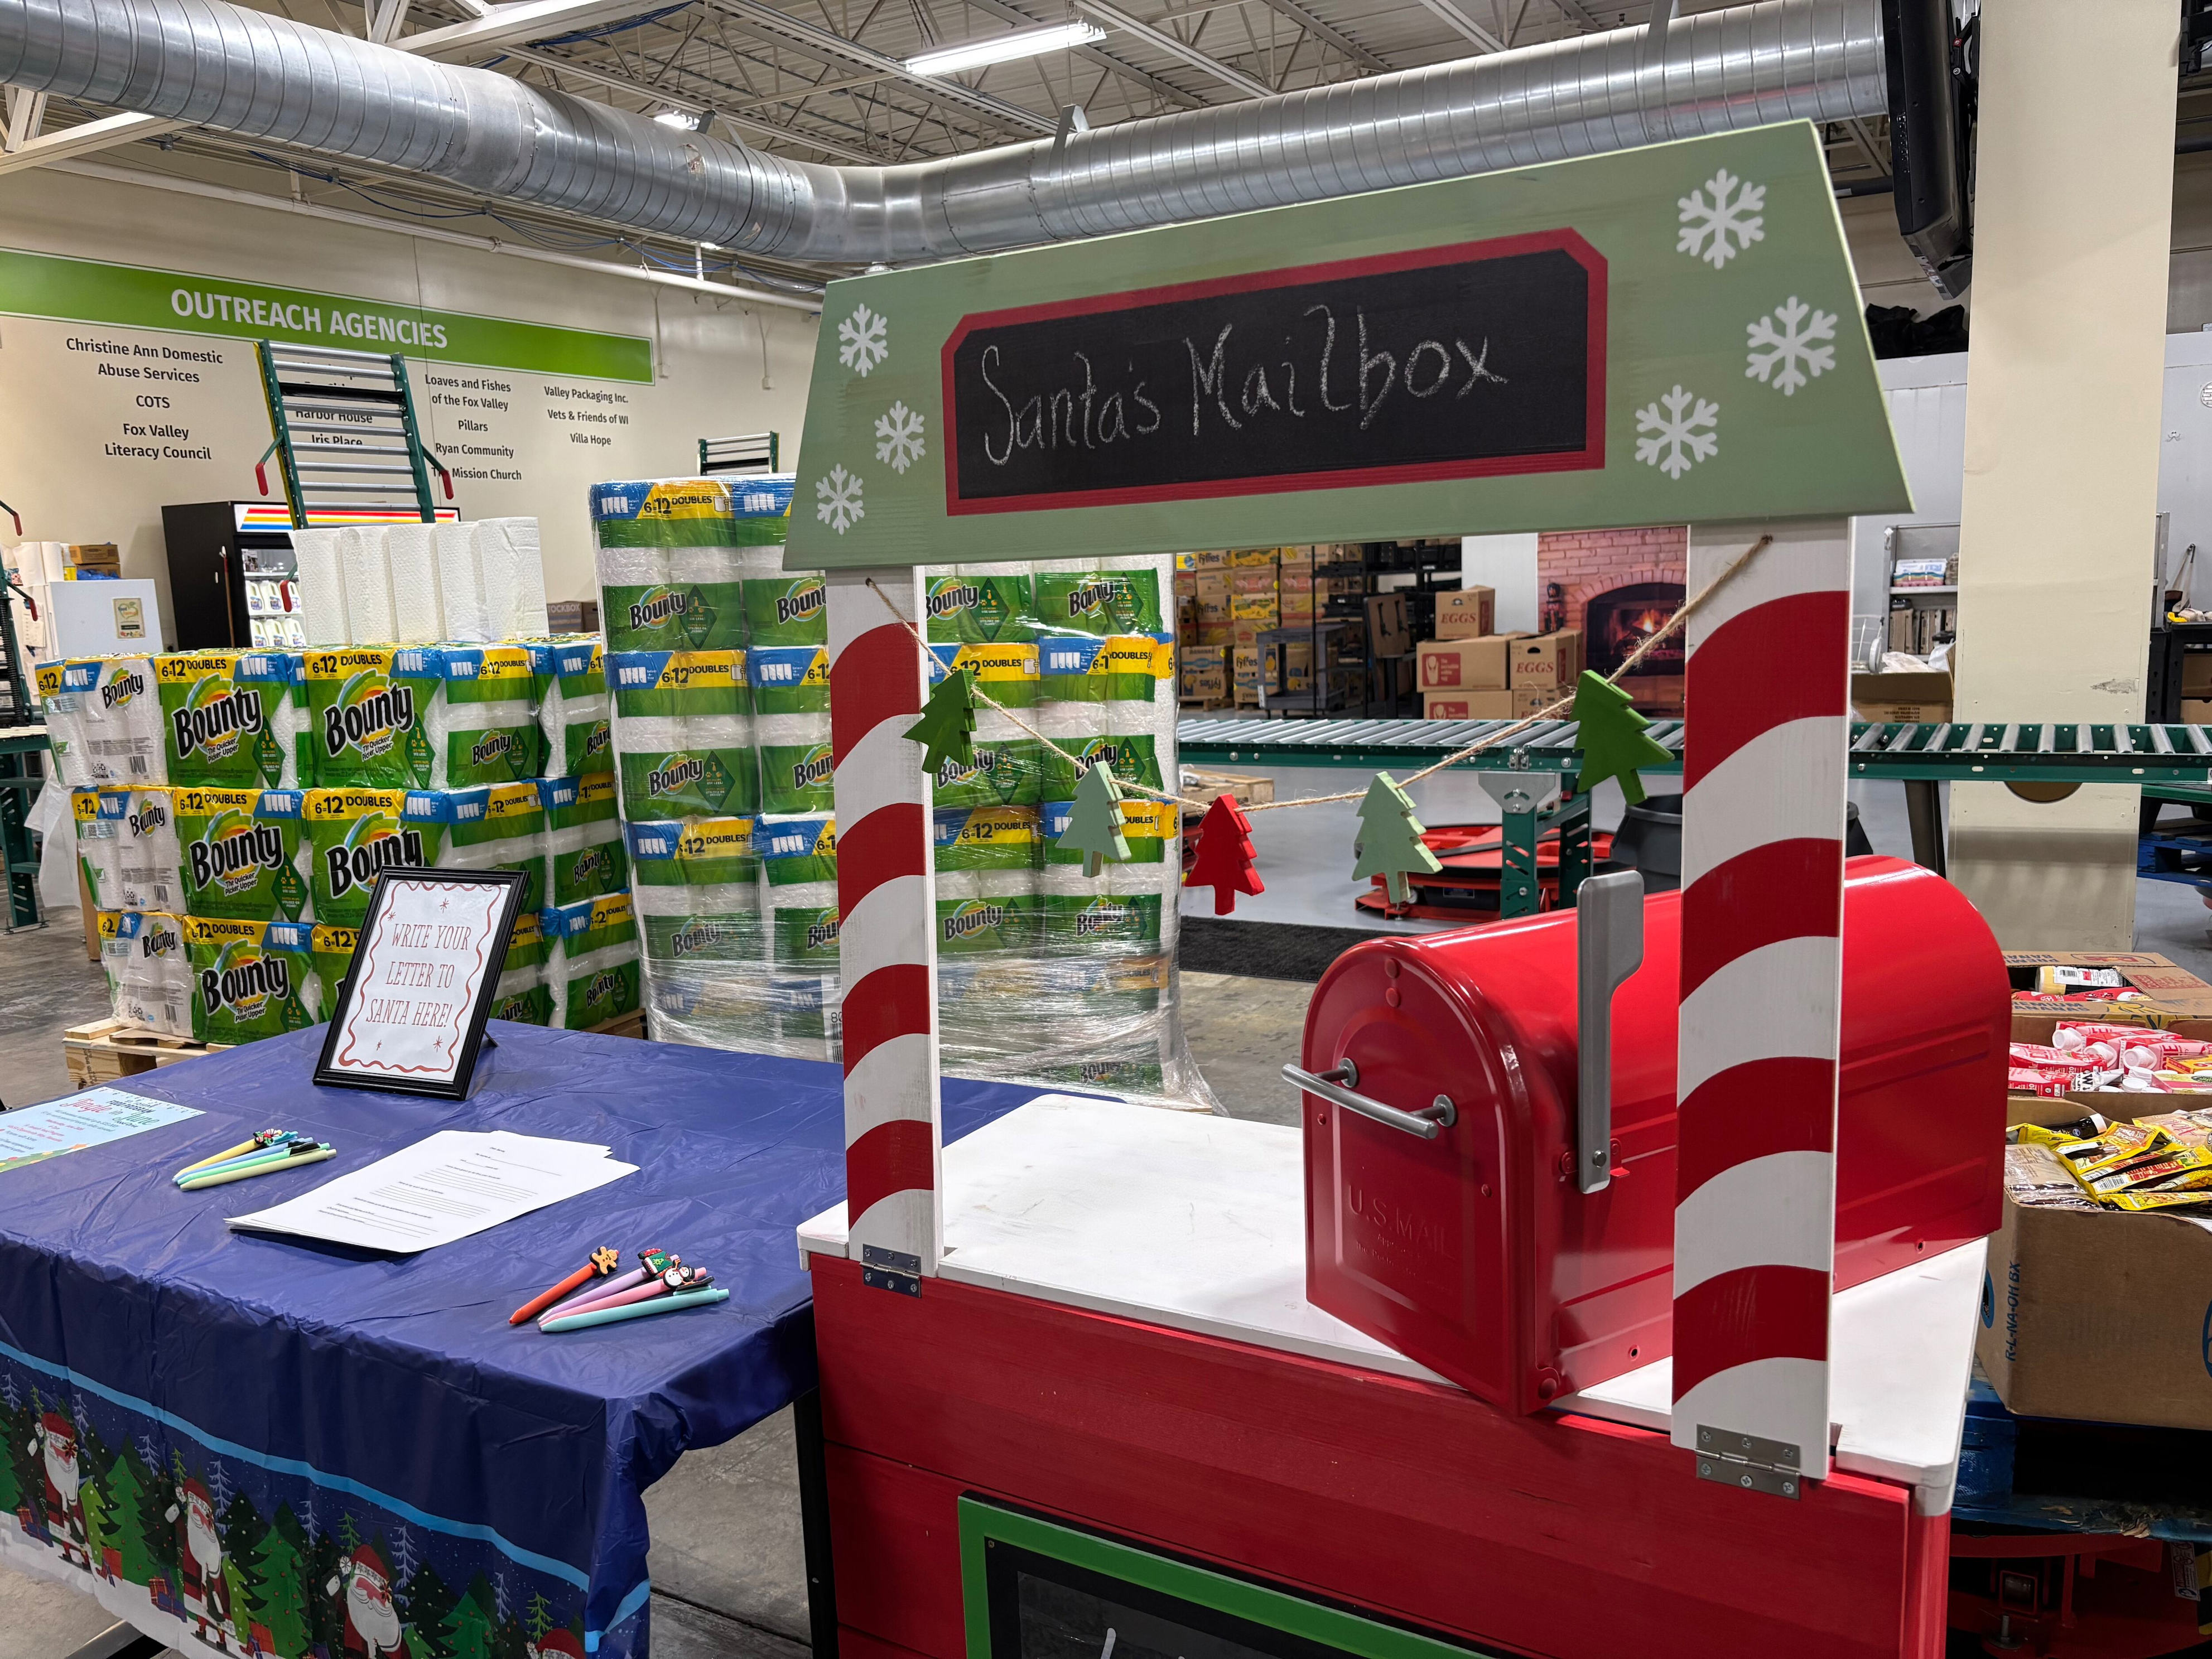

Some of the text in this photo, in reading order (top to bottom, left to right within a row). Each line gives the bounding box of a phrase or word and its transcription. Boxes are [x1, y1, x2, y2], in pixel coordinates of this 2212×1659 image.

[171, 289, 447, 349] OUTREACH AGENCIES
[66, 338, 223, 364] Christine Ann Domestic
[98, 363, 200, 383] Abuse Services
[425, 374, 511, 392] Loaves and Fishes
[981, 305, 1509, 466] Santa's Mailbox
[136, 396, 170, 408] COTS
[544, 386, 628, 403] Valley Packaging Inc.
[432, 394, 508, 412] of the Fox Valley
[548, 409, 628, 425] Vets & Friends of WI
[123, 423, 189, 440] Fox Valley
[458, 420, 488, 432] Pillars
[312, 433, 362, 445] Iris Place
[571, 433, 611, 445] Villa Hope
[105, 443, 211, 460] Literacy Council
[436, 443, 514, 459] Ryan Community
[452, 467, 522, 480] Mission Church
[672, 496, 712, 505] DOUBLES
[630, 591, 686, 630] Bounty
[1441, 614, 1476, 624] EGGS
[187, 659, 226, 669] DOUBLES
[340, 654, 382, 665] DOUBLES
[982, 659, 1021, 667] DOUBLES
[1516, 662, 1553, 673] EGGS
[689, 665, 729, 674] DOUBLES
[102, 674, 144, 709] Bounty
[172, 686, 262, 758] Bounty
[325, 683, 413, 755] Bounty
[216, 738, 236, 750] Quicker
[370, 736, 390, 747] Quicker
[375, 744, 392, 754] Upper
[473, 734, 511, 765] Bounty
[208, 745, 239, 761] Picker Upper
[649, 759, 703, 797] Bounty
[793, 754, 833, 789] Boun
[591, 782, 611, 790] DOUBLES
[205, 794, 247, 804] DOUBLES
[346, 797, 393, 807] DOUBLES
[995, 822, 1030, 830] DOUBLES
[706, 835, 745, 844] DOUBLES
[190, 823, 282, 889] Bounty
[235, 873, 255, 883] Quicker
[225, 880, 257, 895] Picker Upper
[213, 924, 254, 935] DOUBLES
[944, 905, 1002, 941] Bounty
[392, 924, 471, 950] WRITE YOUR
[672, 924, 721, 957] Bounty
[385, 962, 455, 988] LETTER TO
[203, 954, 287, 1014] Bounty
[244, 1002, 263, 1011] Quicker
[248, 1008, 266, 1018] Upper
[366, 999, 452, 1027] SANTA HERE!
[59, 1098, 113, 1114] Jingle
[112, 1110, 160, 1125] June
[2009, 1261, 2020, 1282] BX
